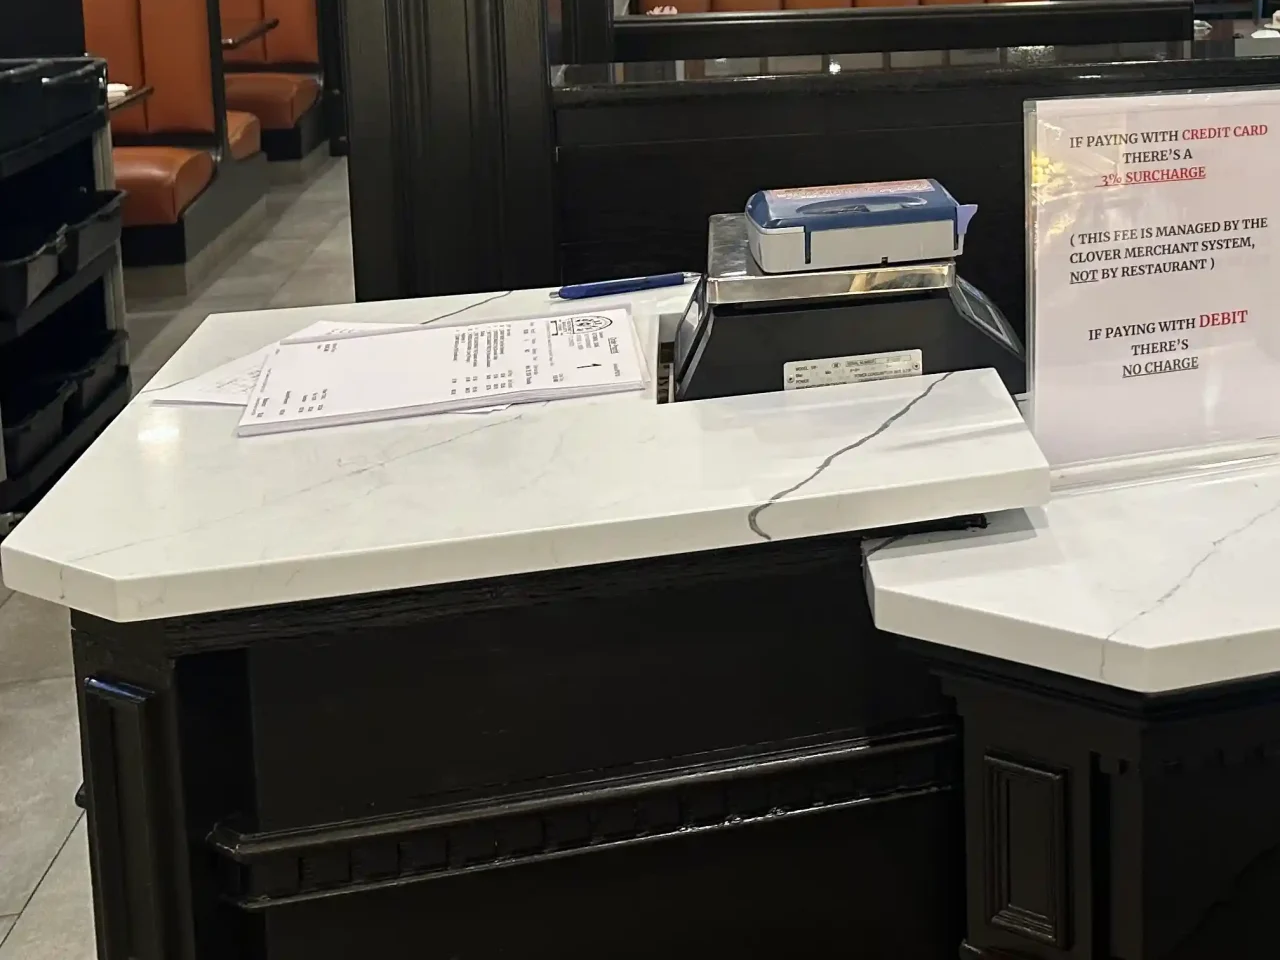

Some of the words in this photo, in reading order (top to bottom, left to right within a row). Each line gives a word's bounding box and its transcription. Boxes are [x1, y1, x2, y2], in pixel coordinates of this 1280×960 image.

[1069, 136, 1084, 148] IF
[1086, 133, 1138, 148] PAYING
[1141, 130, 1179, 144] WITH
[1182, 127, 1231, 141] CREDIT
[1233, 124, 1268, 138] CARD
[1182, 149, 1192, 160] A
[1101, 173, 1122, 187] 3%
[1125, 166, 1206, 183] SURCHARGE
[1069, 233, 1075, 247] (
[1078, 231, 1110, 245] THIS
[1113, 229, 1138, 241] FEE
[1140, 227, 1152, 239] IS
[1156, 221, 1221, 238] MANAGED
[1223, 220, 1239, 234] BY
[1242, 218, 1268, 231] THE
[1069, 249, 1122, 264] CLOVER
[1124, 242, 1199, 259] MERCHANT
[1201, 236, 1255, 252] SYSTEM,
[1069, 269, 1099, 284] NOT
[1101, 267, 1118, 280] BY
[1121, 259, 1208, 278] RESTAURANT
[1209, 258, 1215, 270] )
[1088, 329, 1102, 341] IF
[1105, 322, 1156, 339] PAYING
[1159, 318, 1196, 332] WITH
[1199, 310, 1248, 328] DEBIT
[1122, 364, 1142, 378] NO
[1144, 357, 1199, 374] CHARGE
